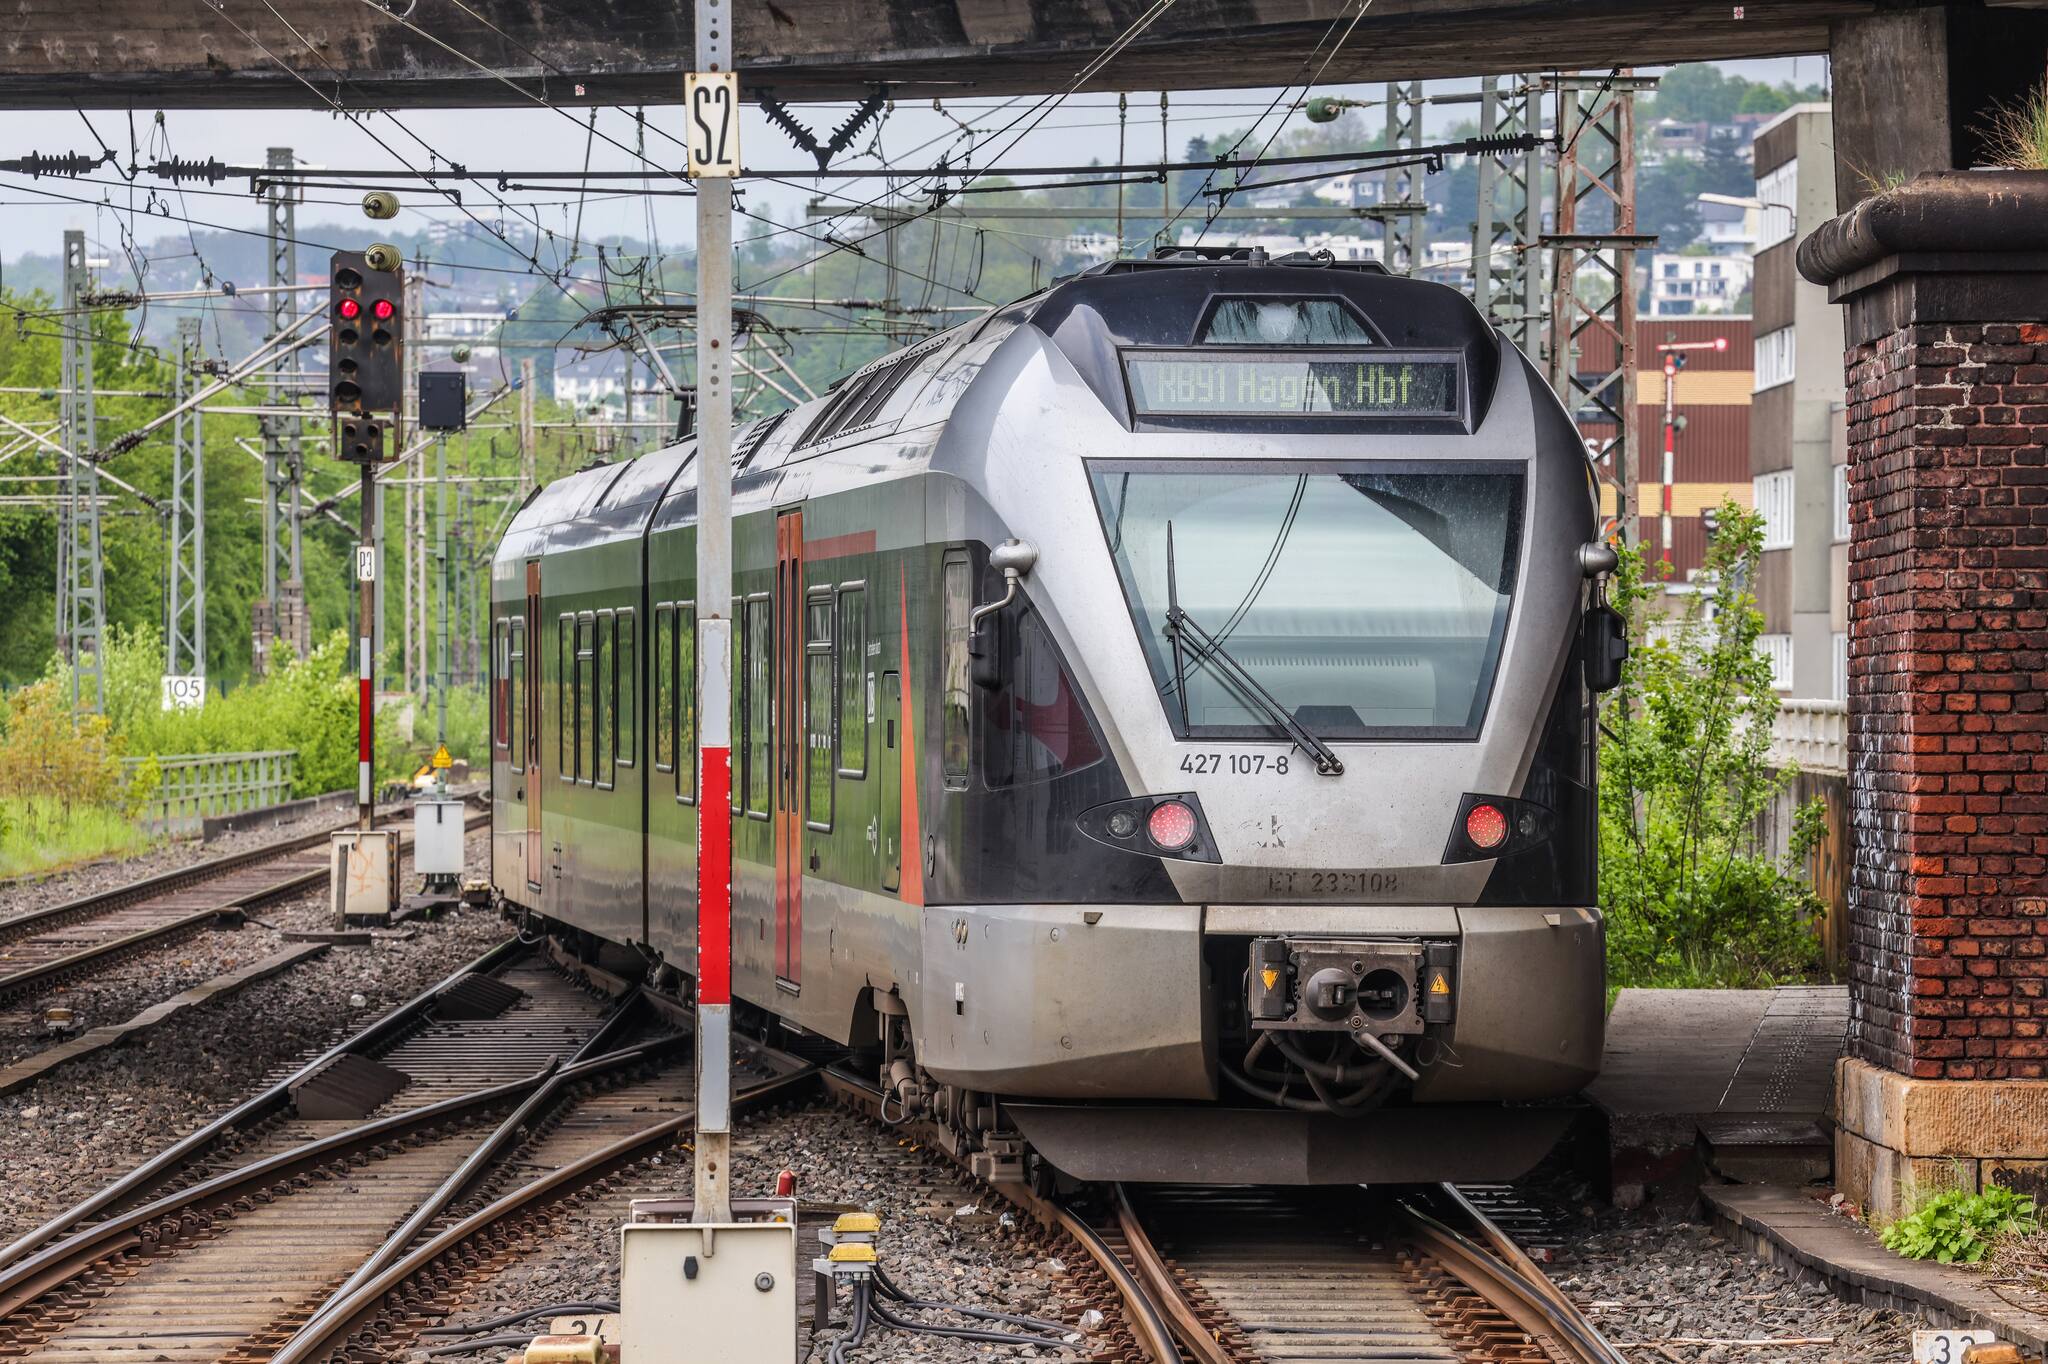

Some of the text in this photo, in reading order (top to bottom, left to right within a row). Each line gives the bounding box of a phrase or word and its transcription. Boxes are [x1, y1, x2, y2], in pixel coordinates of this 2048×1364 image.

[693, 85, 732, 166] S2
[1239, 364, 1341, 409] Hagen
[1357, 363, 1412, 404] Hbf
[360, 551, 372, 577] P3
[167, 679, 201, 698] 105
[1180, 754, 1290, 776] 427 107-8
